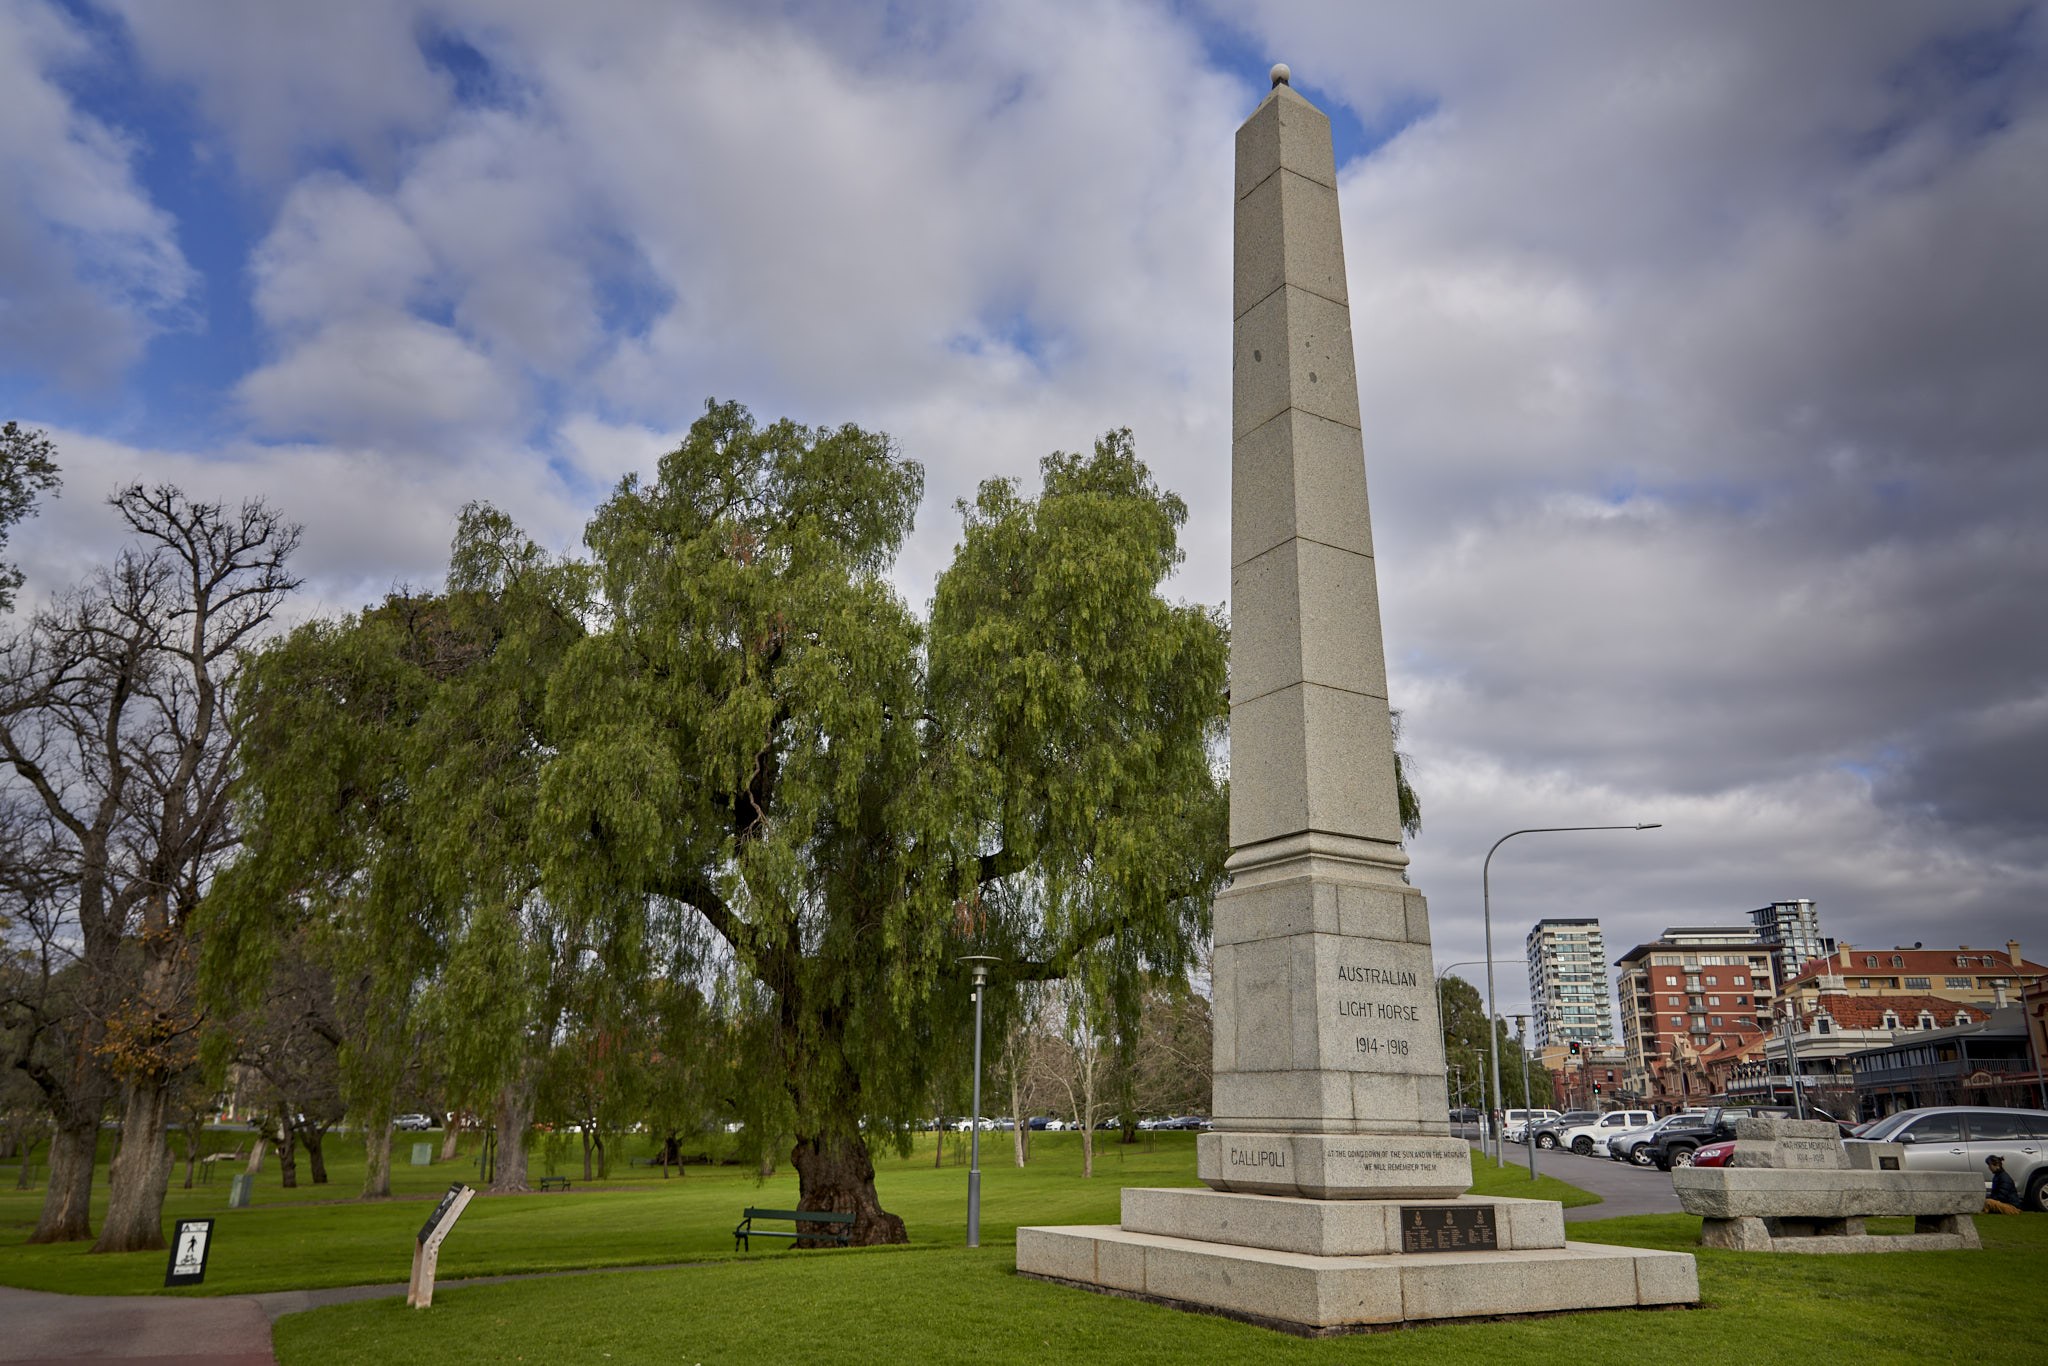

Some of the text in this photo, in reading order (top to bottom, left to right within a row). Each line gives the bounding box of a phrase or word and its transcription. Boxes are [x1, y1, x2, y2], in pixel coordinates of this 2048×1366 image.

[1338, 965, 1417, 987] AUSTRALIAN
[1339, 1000, 1420, 1021] LIGHT HORSE
[1782, 1141, 1834, 1151] WAR HORSE MEMORIAL
[1231, 1147, 1285, 1168] GALLIPOLI
[1335, 1150, 1346, 1158] THE
[1348, 1150, 1364, 1158] GOING
[1365, 1150, 1380, 1158] DOWN
[1381, 1150, 1388, 1158] OF
[1391, 1151, 1401, 1159] THE
[1432, 1151, 1443, 1159] THE
[1443, 1151, 1467, 1159] MORNING
[1363, 1163, 1437, 1171] WE WILL REMEMBER THEM
